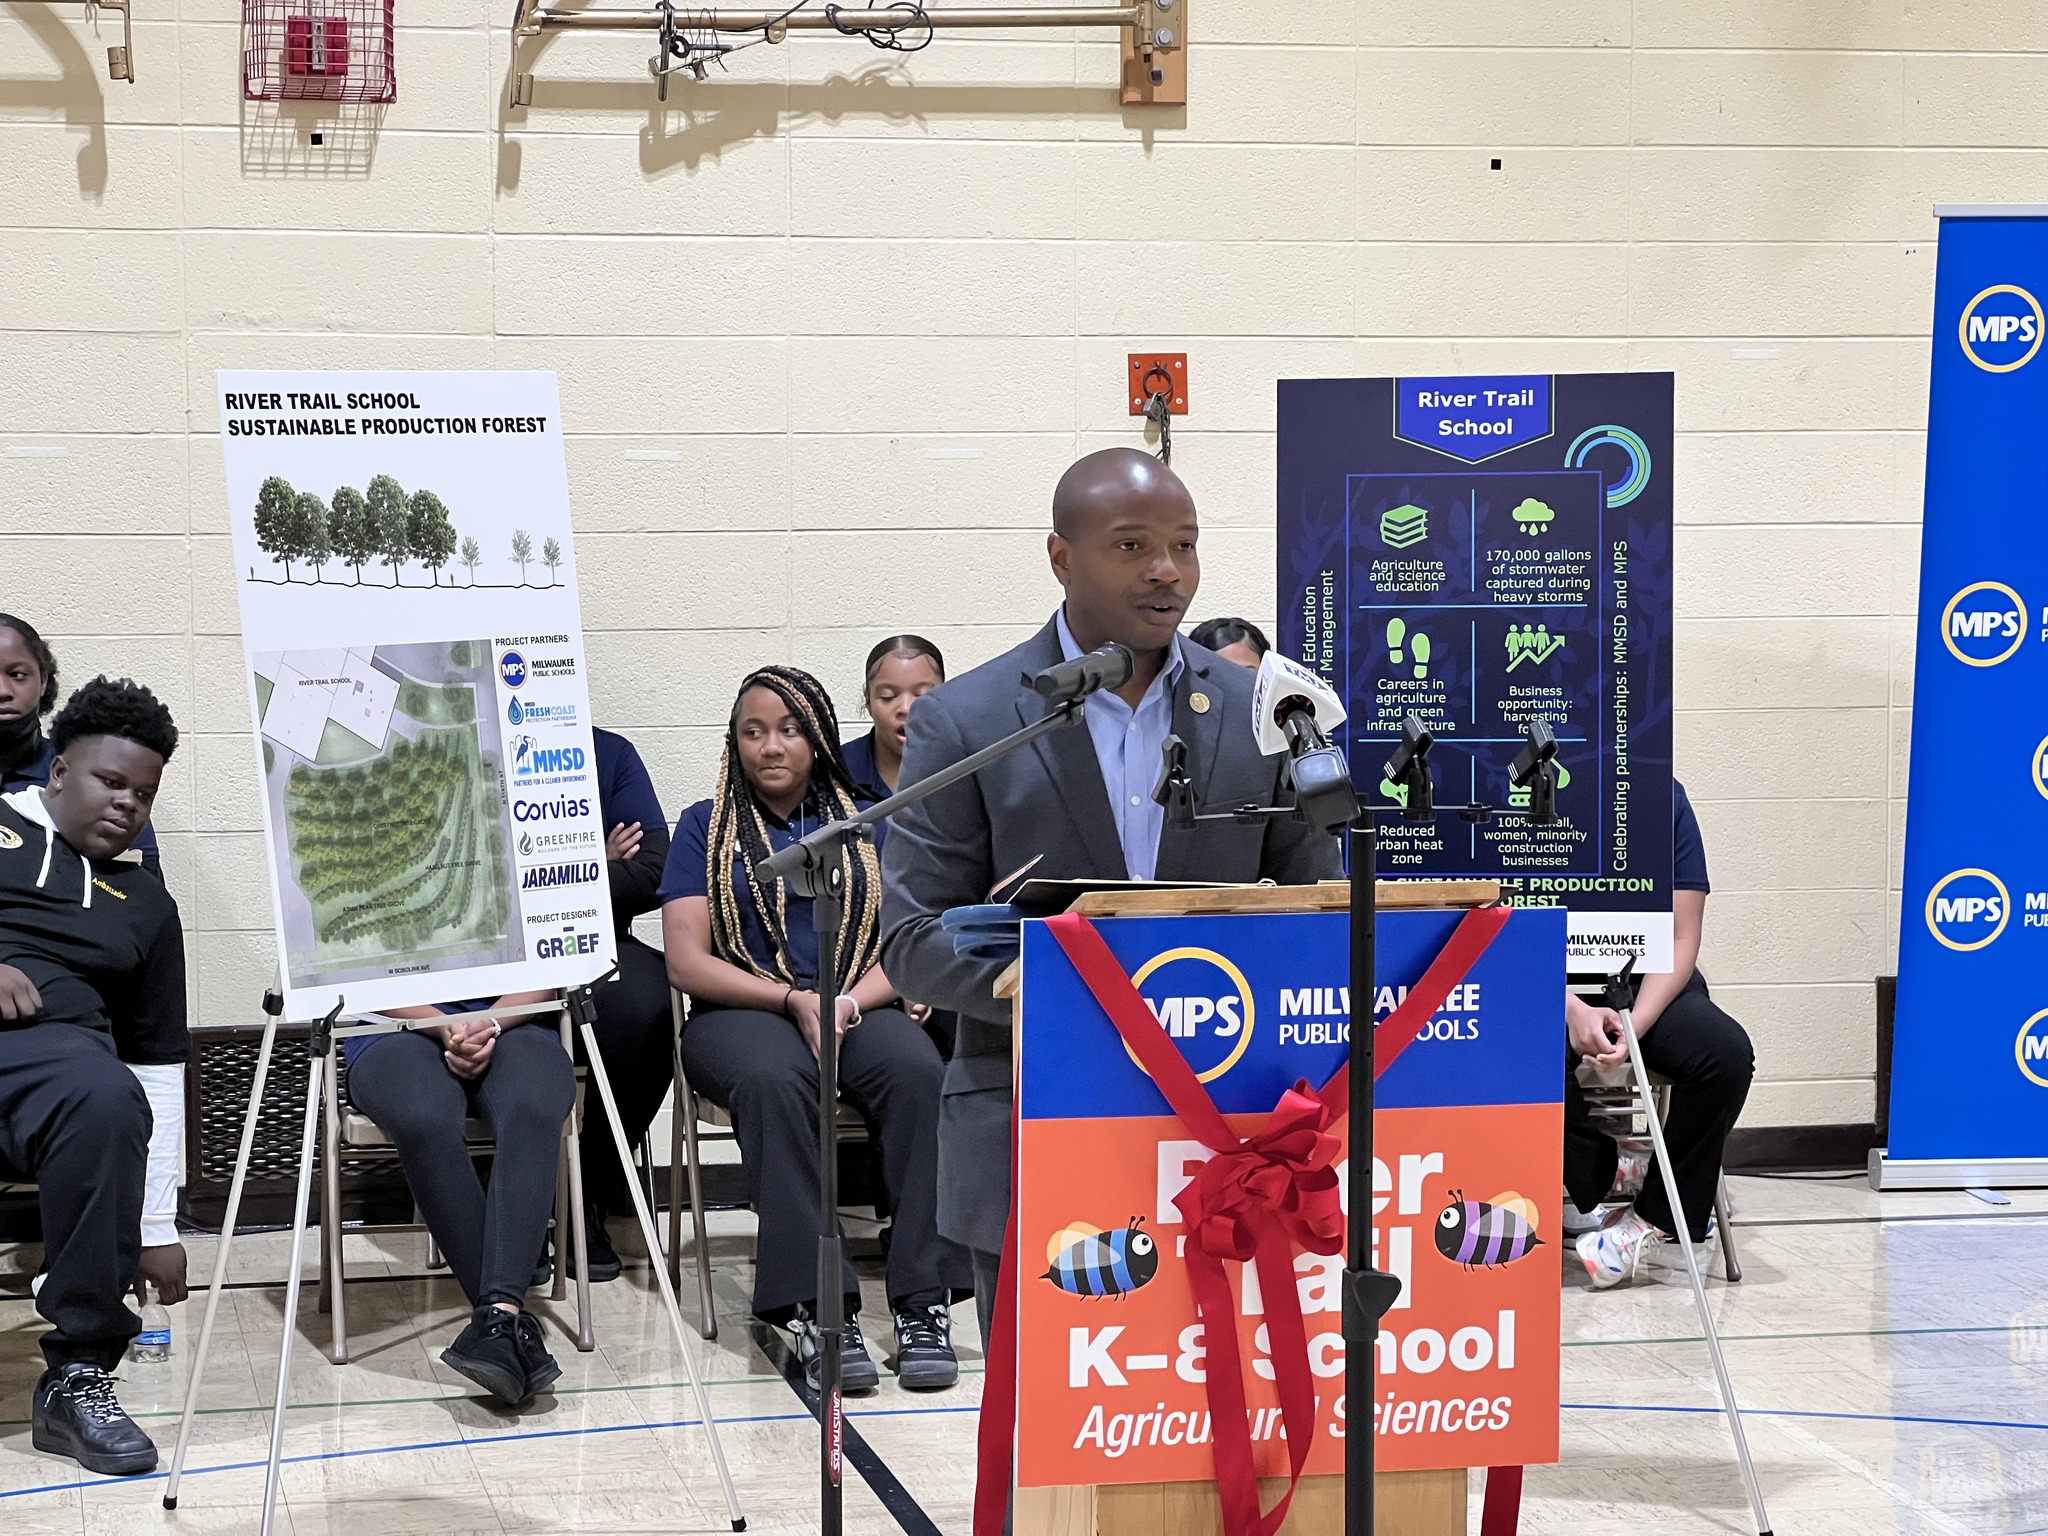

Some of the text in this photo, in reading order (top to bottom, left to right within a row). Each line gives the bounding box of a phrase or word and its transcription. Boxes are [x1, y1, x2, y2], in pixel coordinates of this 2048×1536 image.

[1969, 315, 2036, 342] MPS
[225, 393, 420, 410] RIVER TRAIL SCHOOL
[1419, 390, 1533, 407] River Trail
[228, 417, 546, 436] SUSTAINABLE PRODUCTION FOREST
[1439, 418, 1512, 435] School
[1486, 549, 1591, 562] 170,000 gallons
[1372, 559, 1443, 573] Agriculture
[1492, 564, 1586, 575] of stormwater
[1369, 570, 1446, 581] and science
[1376, 581, 1439, 591] education
[1486, 577, 1591, 590] captured during
[1494, 591, 1583, 604] heavy storms
[1303, 587, 1316, 662] Education
[1320, 570, 1336, 670] Management
[1952, 611, 2018, 637] MPS
[495, 637, 528, 646] PROJECT
[502, 663, 526, 676] MPS
[532, 658, 575, 669] MILWAUKEE
[1378, 679, 1444, 690] Careers in
[1509, 686, 1563, 697] Business
[1376, 692, 1446, 706] agriculture
[1498, 699, 1573, 711] opportunity:
[1378, 706, 1444, 717] and green
[1613, 541, 1630, 872] Celebrating partnerships: MMSD and MPS
[1504, 711, 1567, 724] harvesting
[533, 747, 585, 773] MMSD
[1380, 825, 1435, 837] Reduced
[1484, 830, 1587, 842] women, minority
[536, 832, 596, 846] GREENFIRE
[1414, 839, 1443, 850] heat
[1498, 843, 1573, 853] construction
[1392, 855, 1423, 864] zone
[1503, 856, 1569, 866] businesses
[1530, 878, 1654, 892] PRODUCTION
[1935, 896, 2002, 923] MPS
[527, 913, 559, 924] PROJECT
[1567, 935, 1645, 945] MILWAUKEE
[1143, 996, 1241, 1037] MPS
